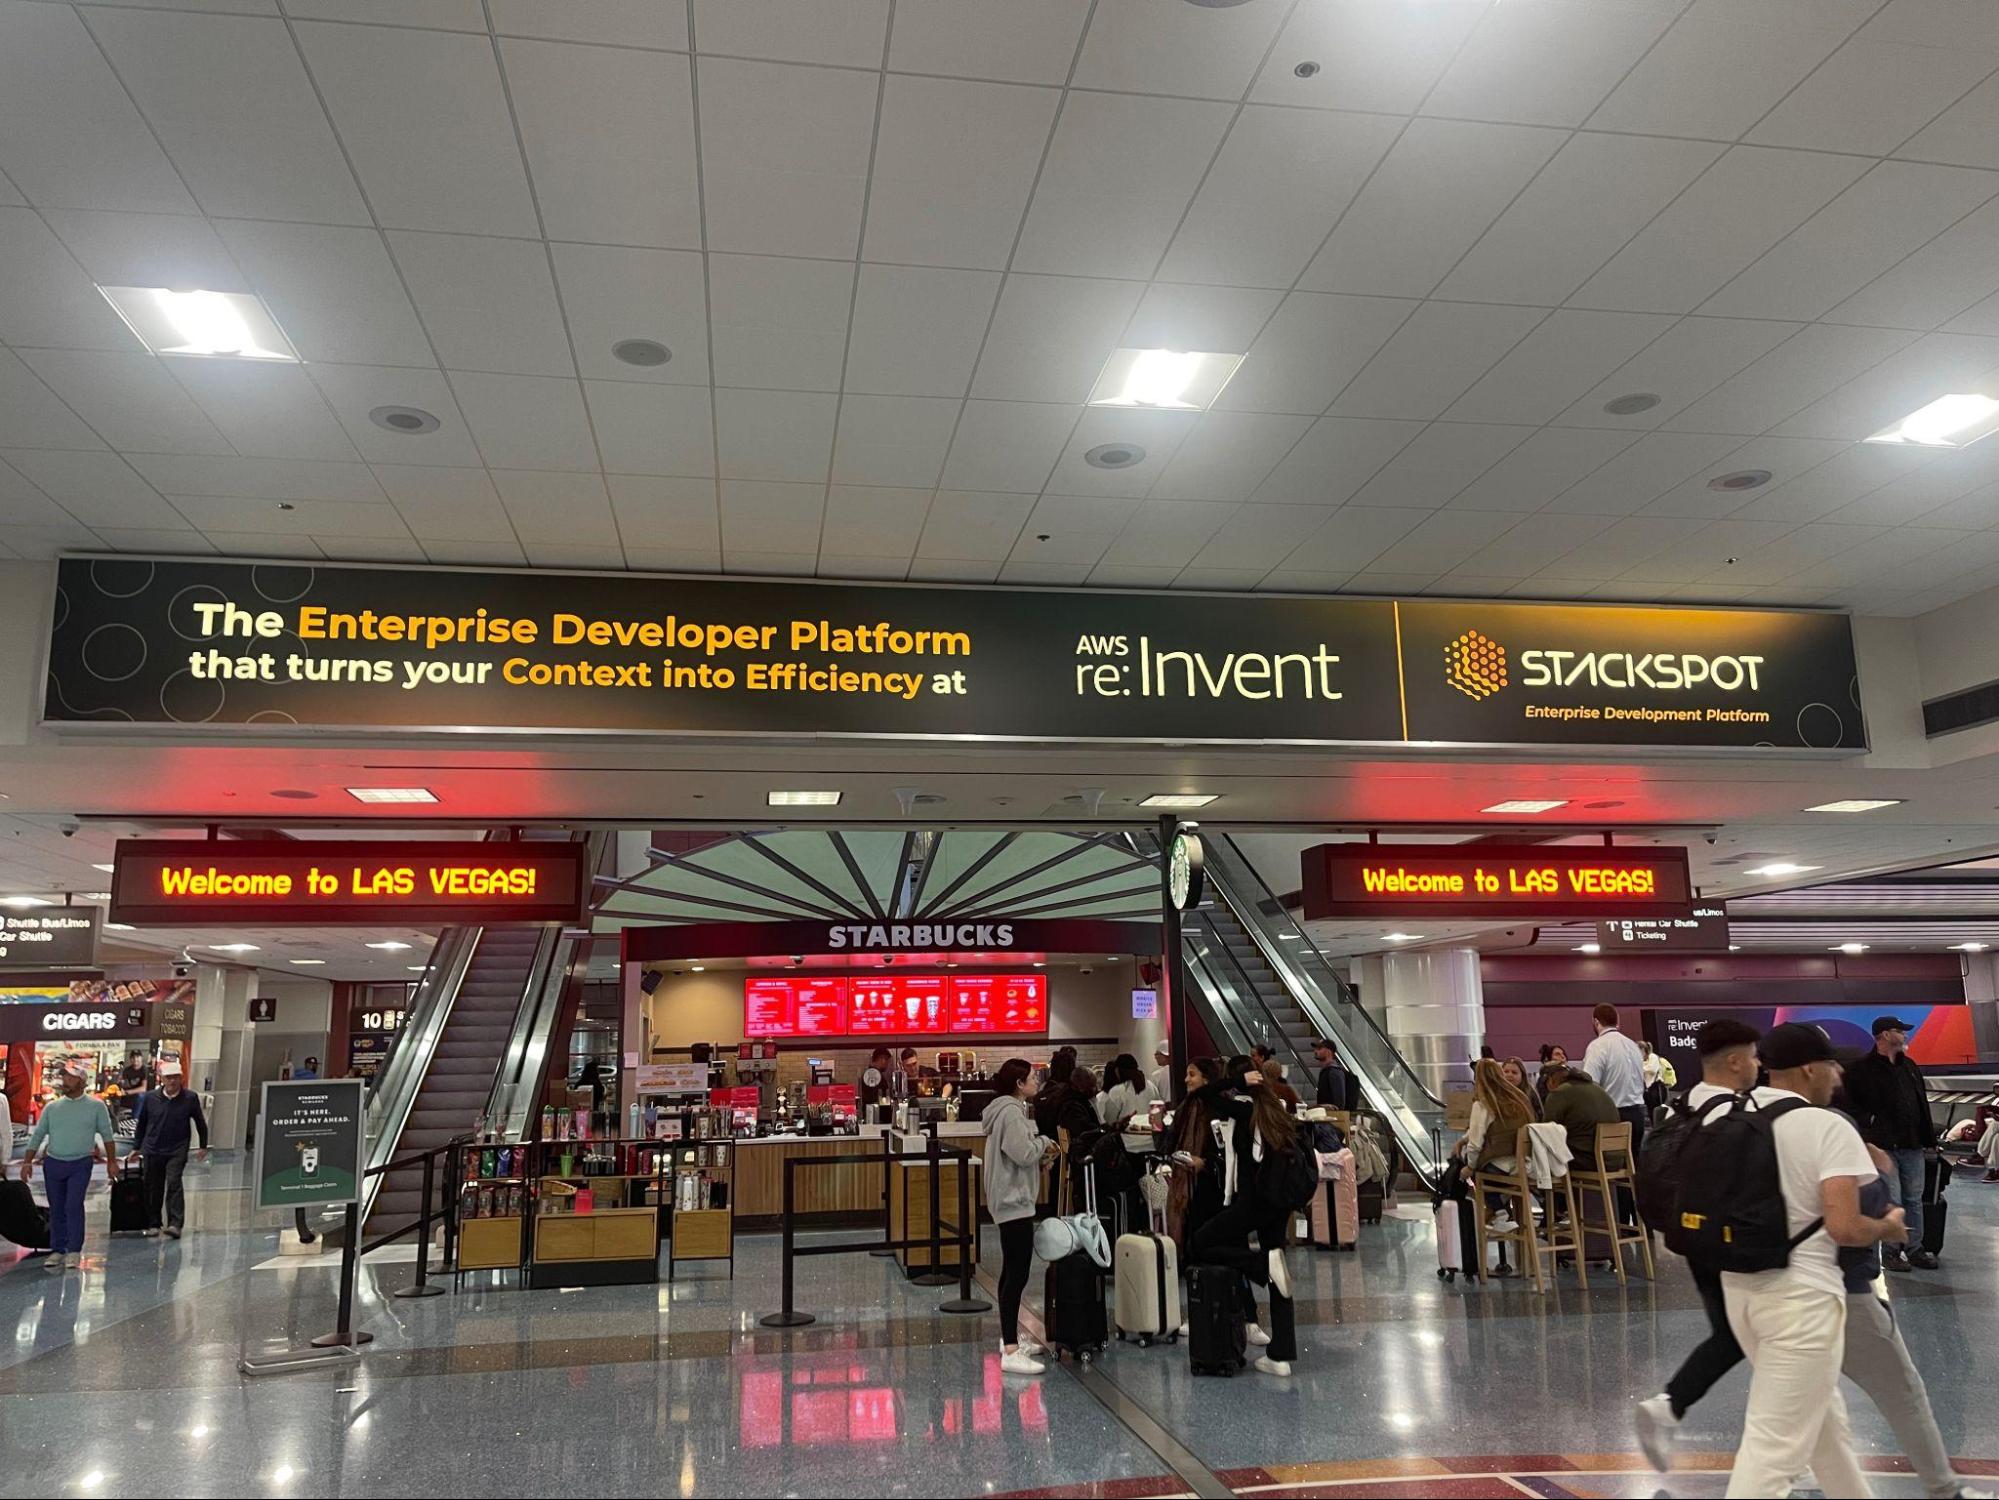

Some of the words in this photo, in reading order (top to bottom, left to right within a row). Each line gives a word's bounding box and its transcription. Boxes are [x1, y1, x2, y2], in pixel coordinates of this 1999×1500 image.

[194, 603, 284, 638] The
[299, 606, 539, 649] Enterprise
[553, 613, 778, 656] Developer
[792, 620, 971, 657] Platform
[1077, 634, 1130, 656] AWS
[189, 650, 276, 680] that
[287, 654, 393, 684] turns
[402, 661, 493, 690] your
[503, 658, 652, 687] Context
[664, 659, 736, 689] into
[747, 662, 924, 701] Efficiency
[932, 671, 968, 695] at
[1076, 636, 1343, 701] re:Invent
[1521, 650, 1765, 691] STACKSPOT
[1525, 705, 1601, 721] Enterprise
[1604, 706, 1702, 723] Development
[1706, 708, 1770, 723] Platform
[161, 867, 292, 895] Welcome
[306, 867, 339, 895] to
[352, 867, 415, 895] LAS
[429, 868, 536, 894] VEGAS!
[1362, 867, 1464, 893] Welcome
[1474, 868, 1500, 892] to
[1508, 868, 1559, 892] LAS
[1567, 868, 1655, 893] VEGAS!
[6, 917, 40, 928] Shuttle
[41, 917, 91, 928] Bus/Limos
[1692, 908, 1724, 917] us/Limos
[1658, 919, 1671, 928] Car
[1674, 919, 1699, 928] Shuttle
[19, 931, 53, 942] Shuttle
[828, 924, 1014, 948] STARBUCKS
[1636, 931, 1667, 941] Ticketing
[42, 1012, 117, 1031] CIGARS
[272, 1118, 299, 1126] ORDER
